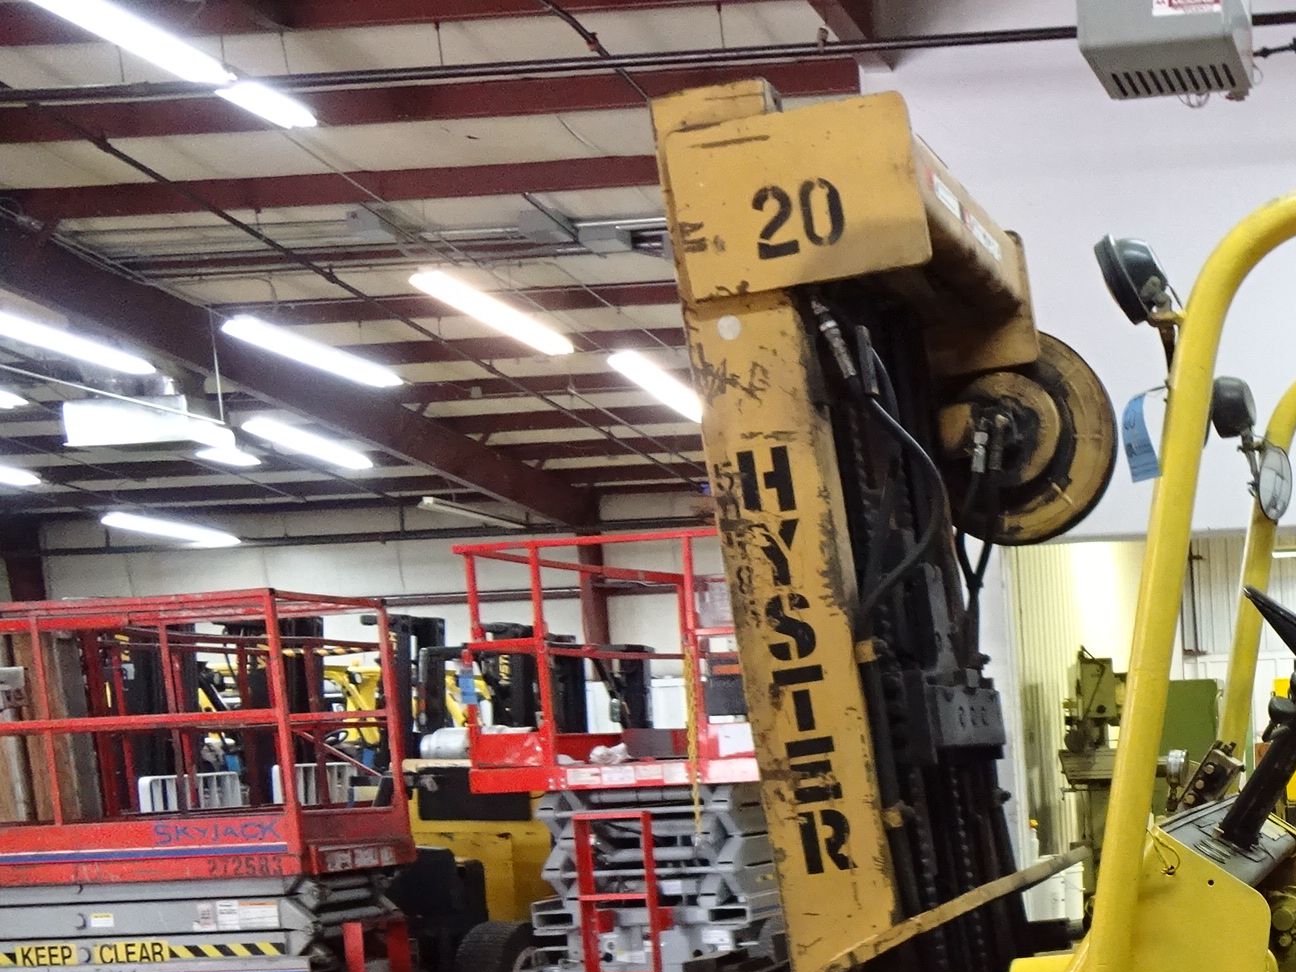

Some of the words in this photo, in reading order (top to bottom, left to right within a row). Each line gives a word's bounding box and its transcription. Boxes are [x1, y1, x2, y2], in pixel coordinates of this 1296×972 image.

[752, 178, 844, 260] 20
[737, 446, 857, 875] HYSTER
[154, 821, 282, 846] SKYJACK
[20, 945, 73, 967] KEEP
[100, 942, 165, 964] CLEAR
